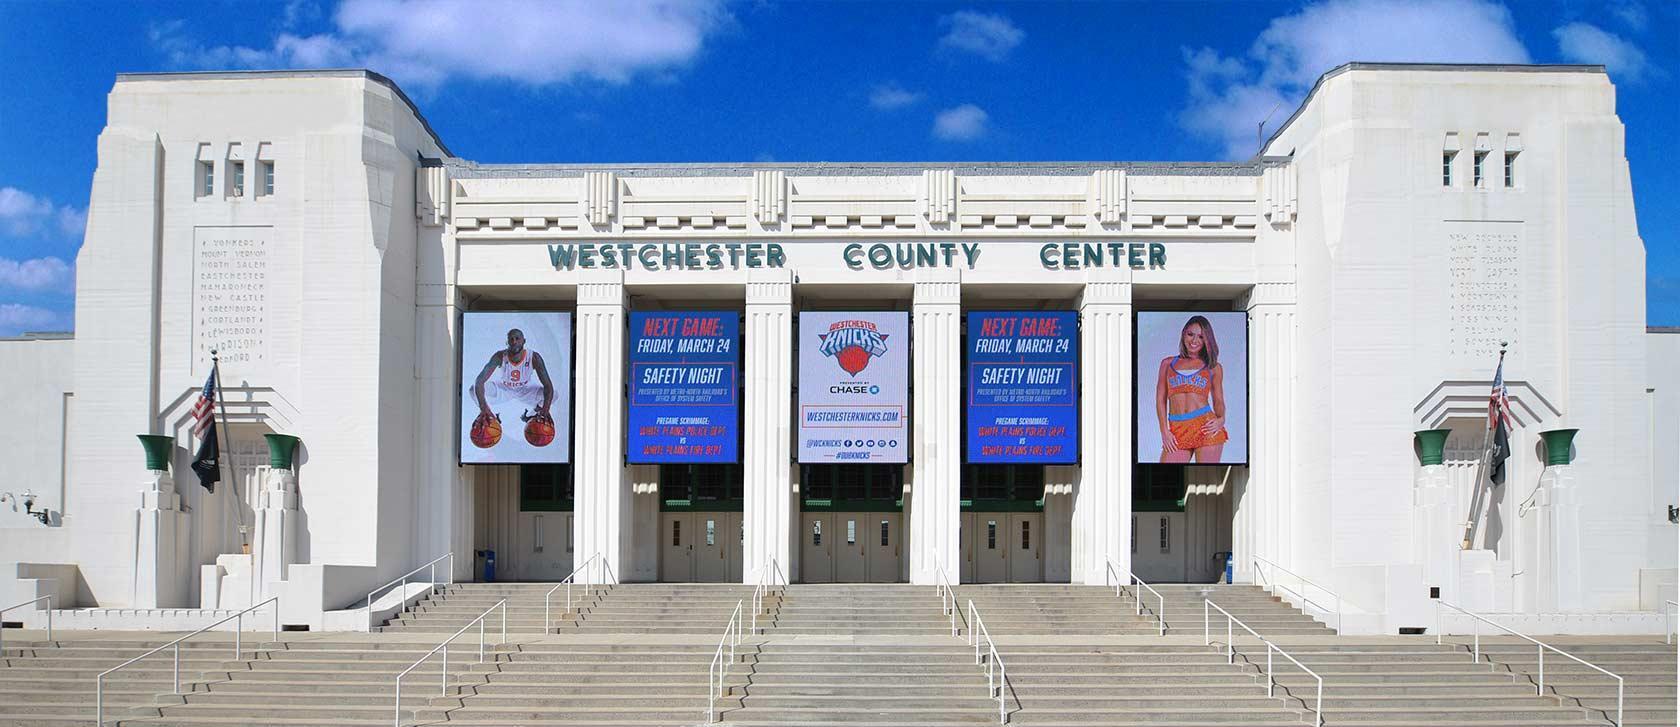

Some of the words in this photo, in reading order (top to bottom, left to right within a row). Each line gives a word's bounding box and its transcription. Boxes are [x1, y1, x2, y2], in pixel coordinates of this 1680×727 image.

[548, 243, 785, 268] WESTCHESTER
[842, 243, 979, 267] COUNTY
[1039, 243, 1167, 267] CENTER
[643, 317, 680, 337] NEXT
[682, 317, 724, 337] GAME:
[828, 319, 878, 332] WESTCHESTER
[981, 317, 1017, 337] NEXT
[1020, 317, 1062, 337] GAME:
[637, 338, 674, 355] FRIDAY,
[677, 338, 715, 353] MARCH
[716, 338, 731, 353] 24
[819, 327, 888, 358] KNICKS
[975, 338, 1012, 355] FRIDAY,
[1015, 338, 1054, 353] MARCH
[1055, 338, 1070, 353] 24
[511, 369, 521, 382] 9
[643, 367, 687, 384] SAFETY
[687, 367, 724, 384] NIGHT
[981, 367, 1025, 384] SAFETY
[1026, 367, 1063, 384] NIGHT
[829, 386, 868, 394] CHASE
[806, 411, 899, 422] WESTCHESTERKNICKS.COM
[679, 437, 687, 445] VS
[1018, 437, 1027, 445] VS
